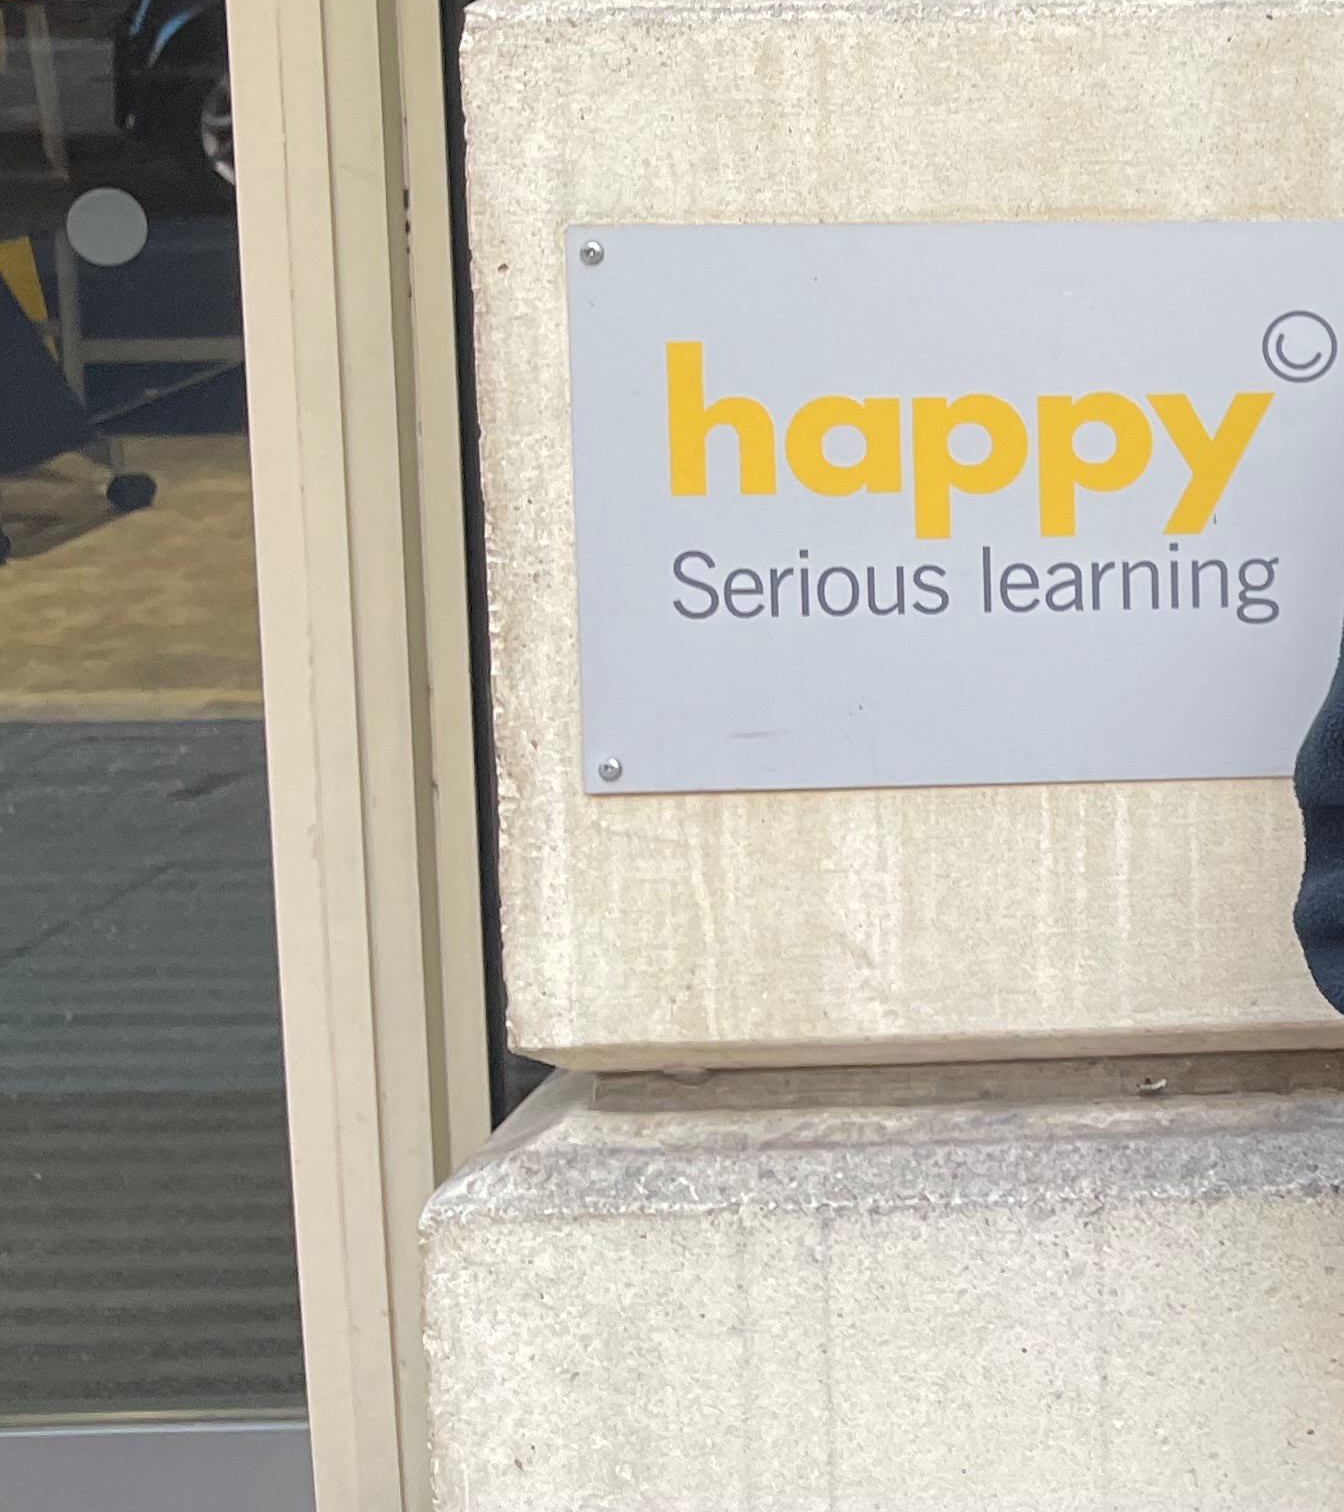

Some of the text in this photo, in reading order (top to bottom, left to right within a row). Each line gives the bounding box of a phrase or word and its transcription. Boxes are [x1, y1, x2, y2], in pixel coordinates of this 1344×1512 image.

[666, 340, 1274, 539] happy
[673, 543, 1280, 625] Serious learning
